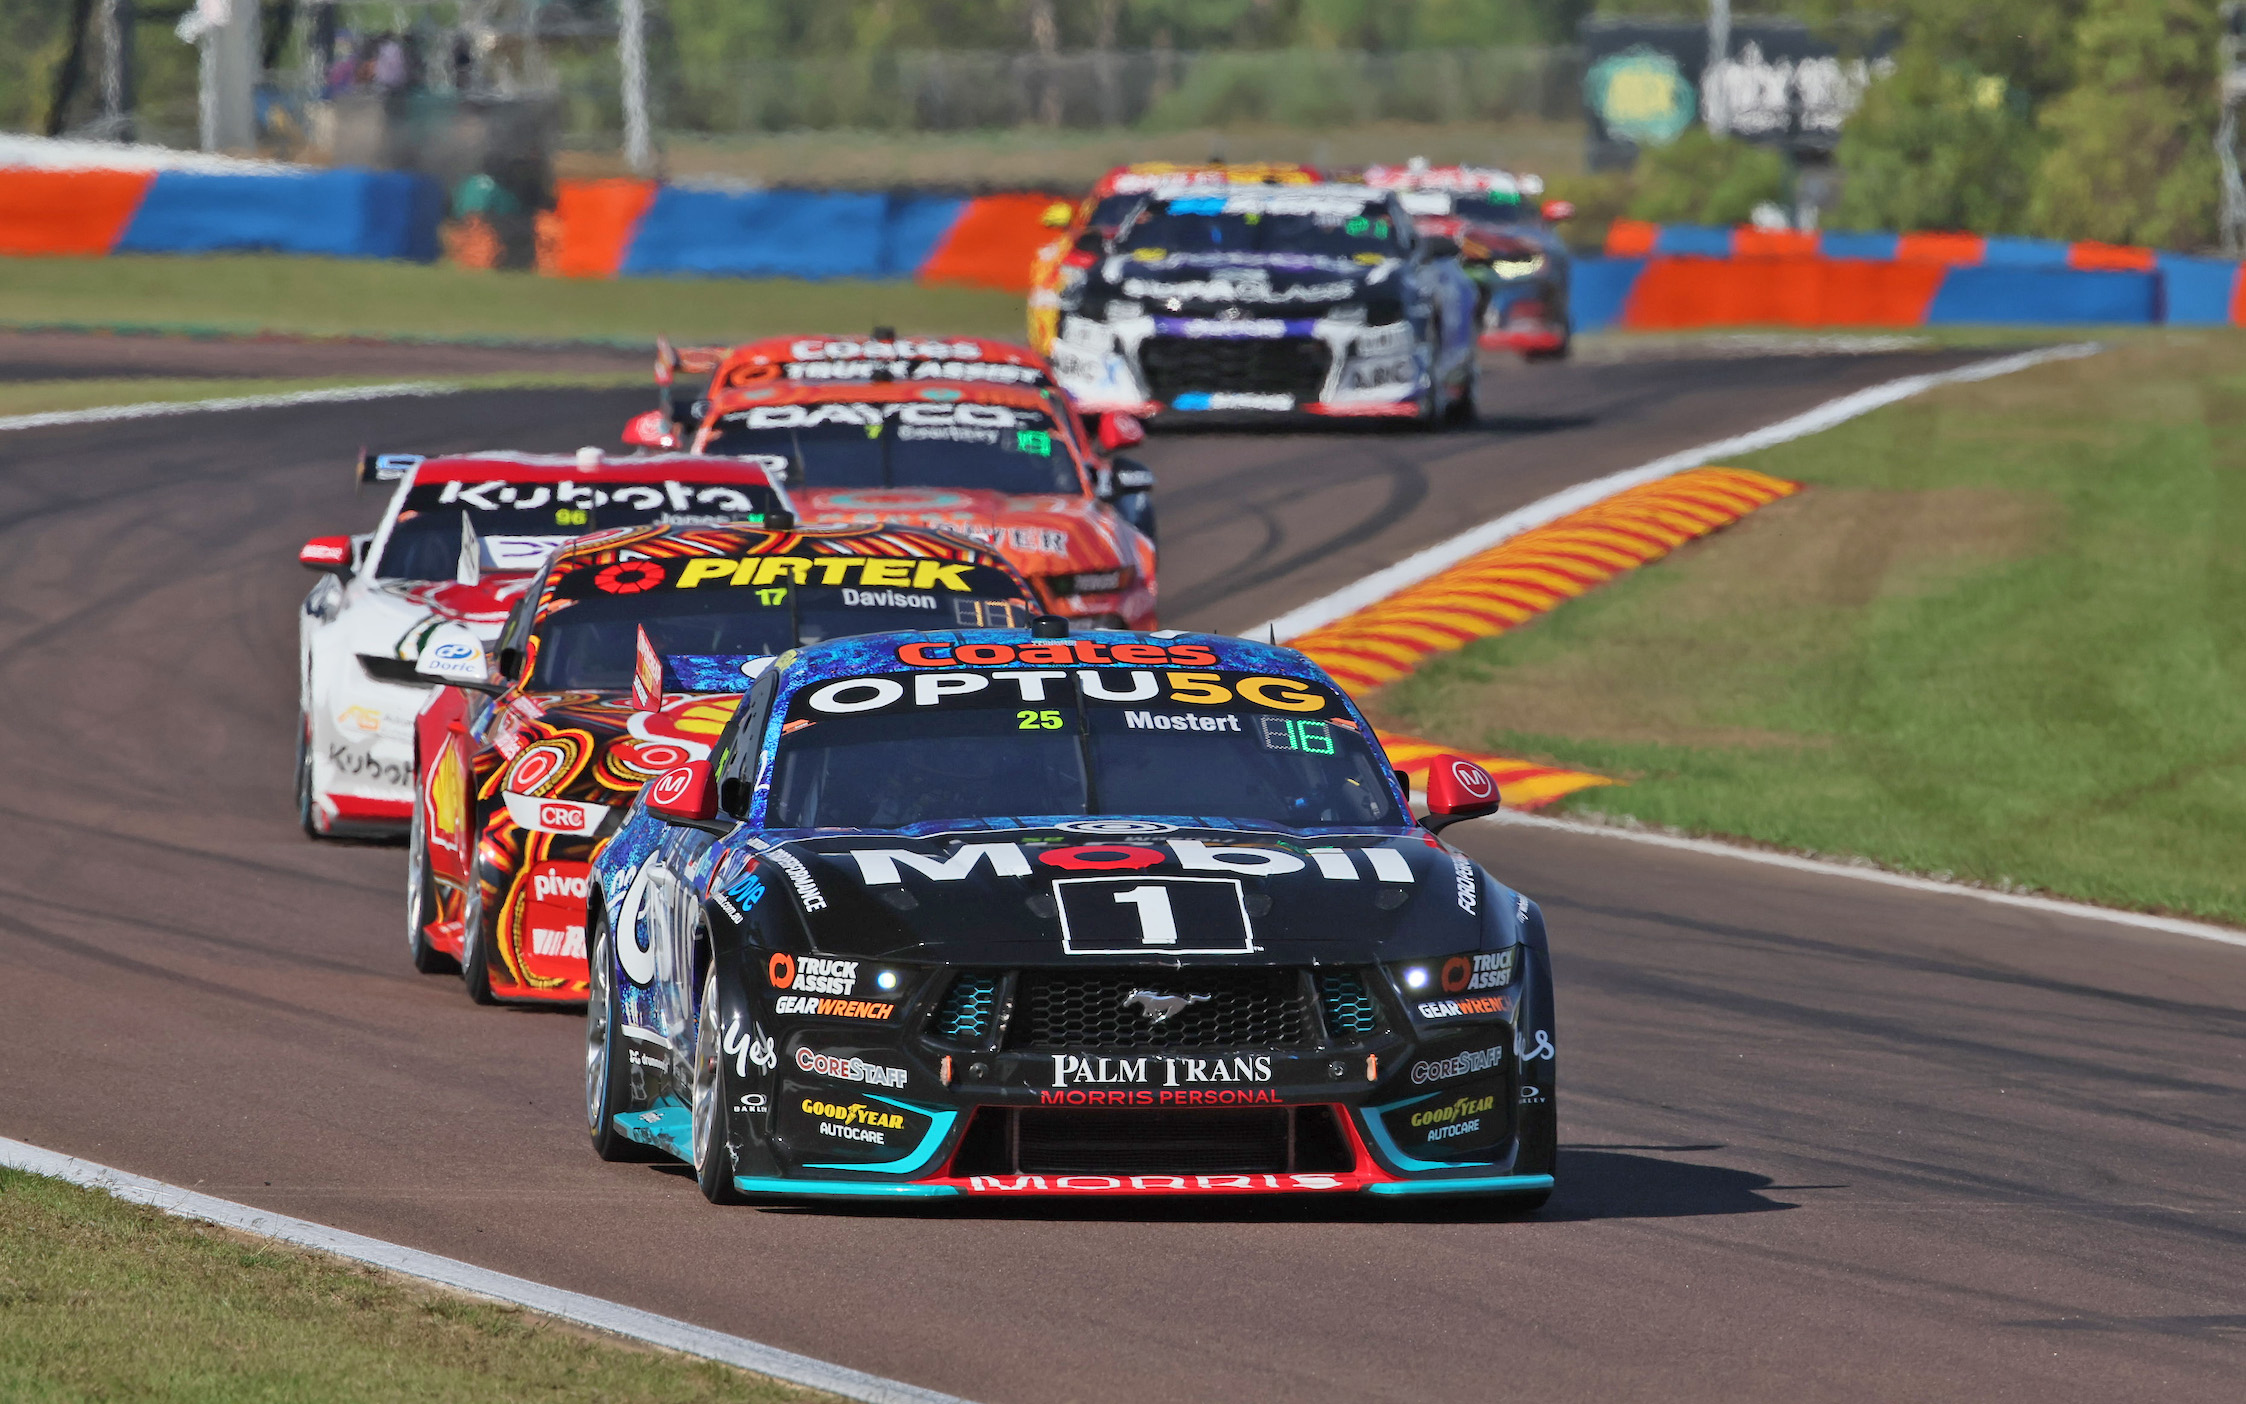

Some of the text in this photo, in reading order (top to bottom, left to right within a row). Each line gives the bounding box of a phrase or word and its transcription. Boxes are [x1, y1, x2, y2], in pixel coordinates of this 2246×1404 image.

[439, 480, 754, 511] Kubota
[675, 556, 976, 592] PIRTEK
[755, 588, 788, 606] 17
[841, 588, 937, 610] Davison
[896, 640, 1219, 668] Coates
[429, 660, 475, 673] Doric
[1016, 710, 1063, 729] 25
[1124, 710, 1241, 732] Mostert
[328, 743, 415, 787] Kubot
[541, 807, 585, 828] CRC
[850, 840, 1415, 885] Mobil
[533, 867, 588, 901] pivo
[1113, 886, 1178, 945] 1
[797, 956, 859, 979] TRUCK
[1473, 950, 1513, 972] TRUCK
[791, 974, 856, 995] ASSIST
[1467, 968, 1512, 990] ASSIST
[775, 996, 895, 1020] GEARWRENCH
[723, 1020, 778, 1077] yes
[1040, 1089, 1284, 1105] MORRIS PERSONAL
[801, 1098, 905, 1130] GOODYEAR
[819, 1121, 885, 1145] AUTOCARE
[1427, 1118, 1480, 1142] AUTOCARE
[970, 1172, 1344, 1193] MORRIS
